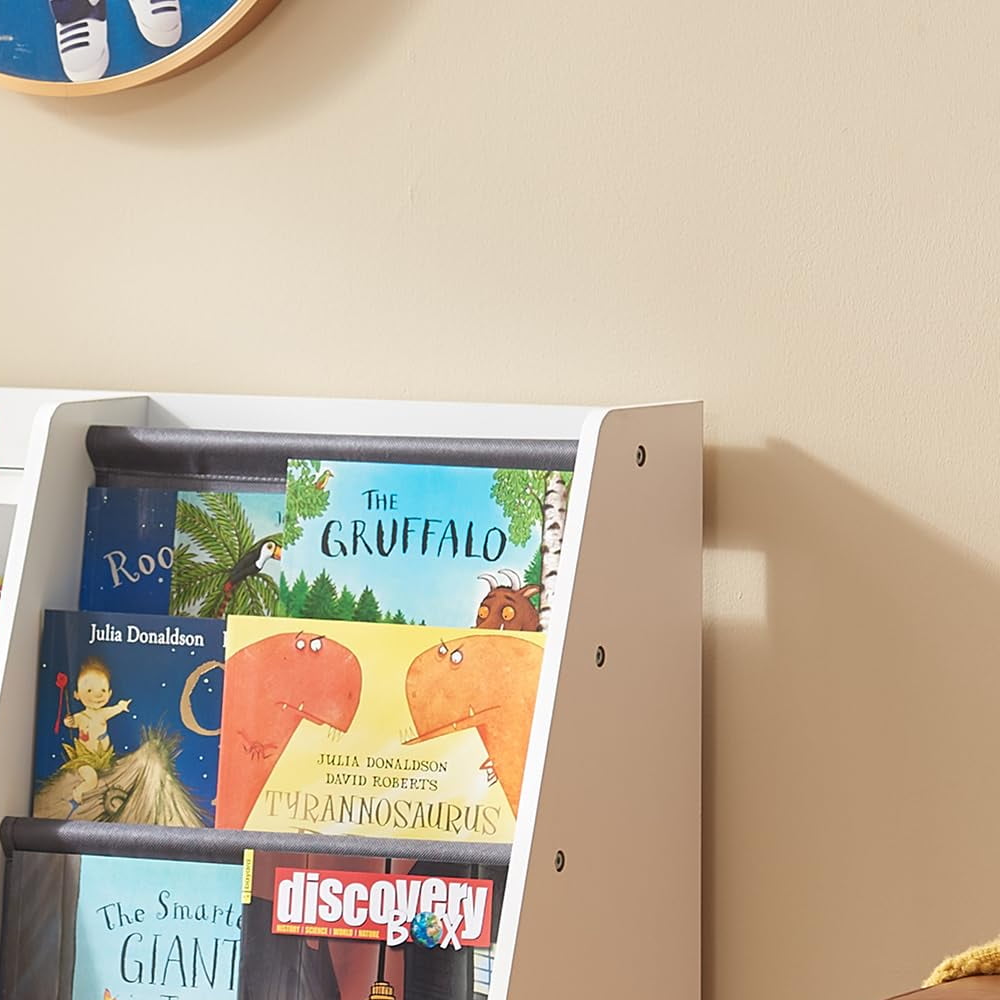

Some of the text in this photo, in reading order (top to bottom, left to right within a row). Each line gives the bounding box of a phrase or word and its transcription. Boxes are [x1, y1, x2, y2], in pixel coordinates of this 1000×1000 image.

[361, 488, 399, 512] THE
[320, 514, 509, 563] GRUFFALO
[89, 623, 122, 644] Julia
[127, 625, 205, 647] Donaldson
[316, 752, 449, 774] JULIA DONALDSON
[325, 772, 439, 792] DAVID ROBERTS
[264, 789, 501, 836] TYRANNOSAURUS
[96, 900, 146, 929] The
[276, 870, 489, 940] discovery
[120, 932, 240, 991] GIANT
